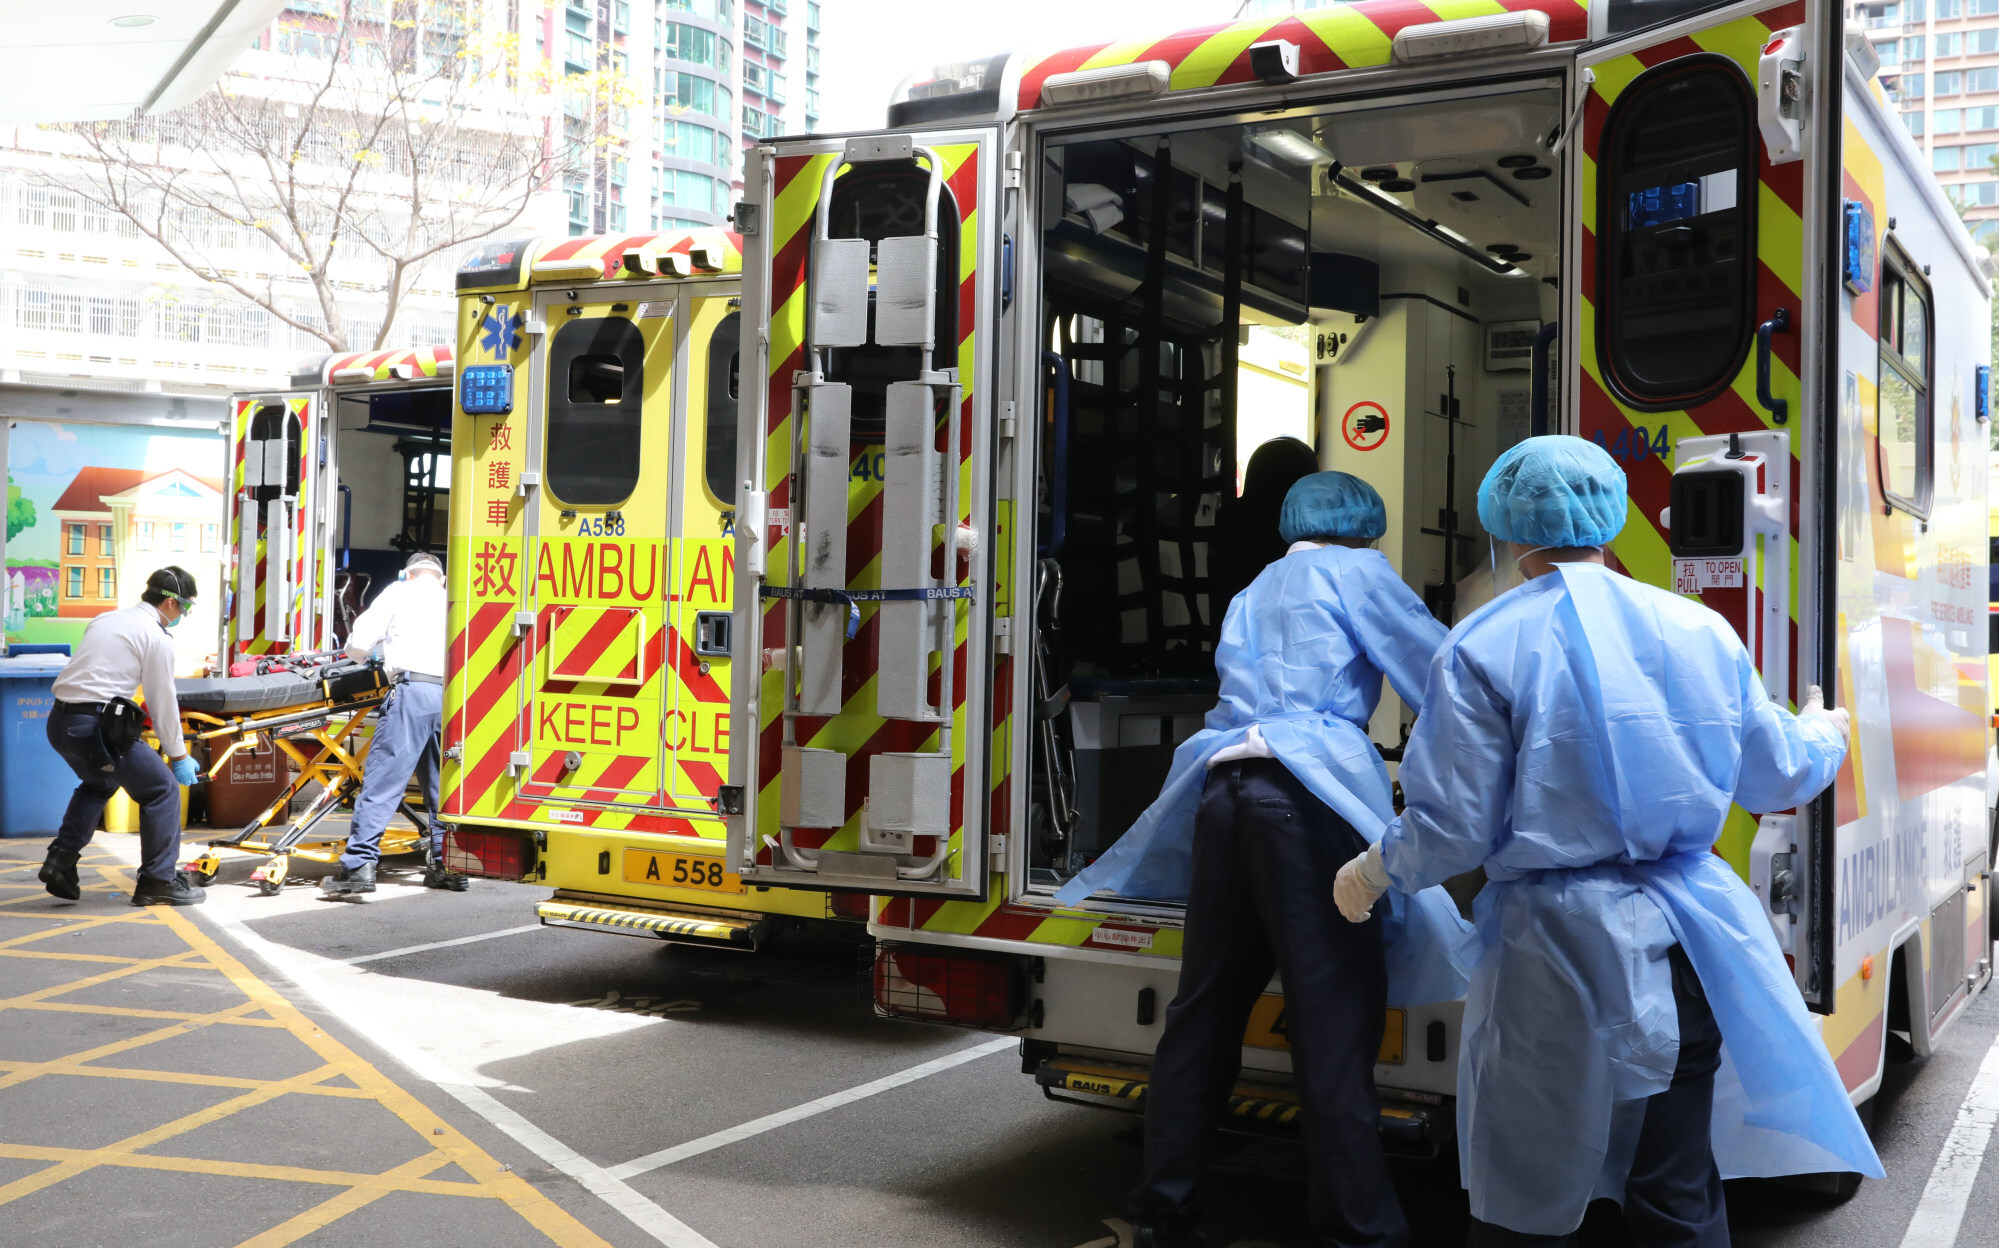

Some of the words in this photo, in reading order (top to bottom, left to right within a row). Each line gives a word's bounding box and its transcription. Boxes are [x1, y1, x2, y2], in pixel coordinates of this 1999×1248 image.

[1592, 424, 1671, 462] A404
[486, 422, 512, 528] 救護車
[577, 517, 626, 537] A558
[473, 541, 518, 598] 救
[1683, 561, 1696, 577] 拉
[1705, 562, 1717, 574] TO
[1718, 561, 1741, 574] OPEN
[770, 587, 792, 598] BAUS
[793, 588, 804, 598] AT
[926, 587, 960, 599] BAUS
[1677, 578, 1700, 594] PULL
[539, 701, 640, 747] KEEP
[646, 855, 661, 881] A
[673, 858, 723, 887] 558
[1838, 820, 1928, 948] AMBULANCE
[1072, 1079, 1111, 1094] BAUS
